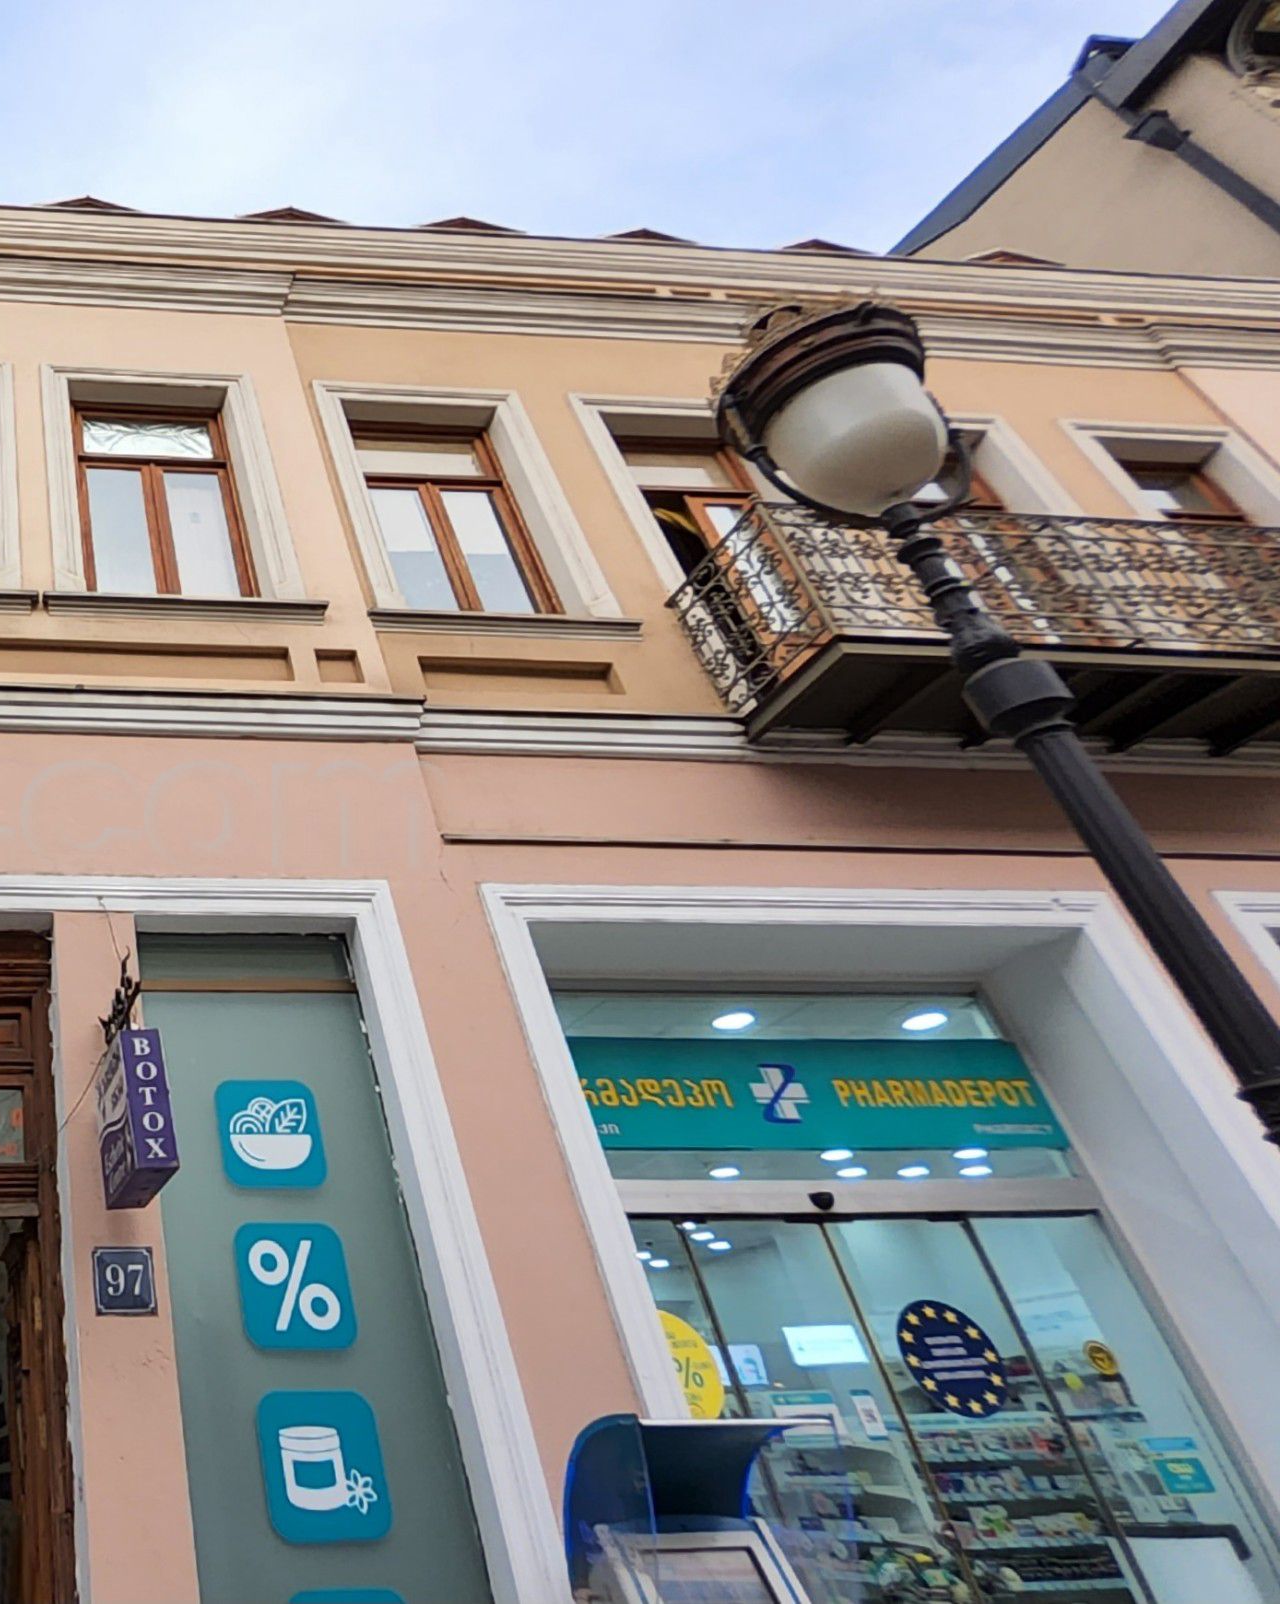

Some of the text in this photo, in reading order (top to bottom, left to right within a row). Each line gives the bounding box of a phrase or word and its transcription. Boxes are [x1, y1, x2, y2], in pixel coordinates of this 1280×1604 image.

[131, 1037, 168, 1159] BOTOX
[832, 1080, 1036, 1107] PHARMADEPOT
[105, 1264, 144, 1296] 97
